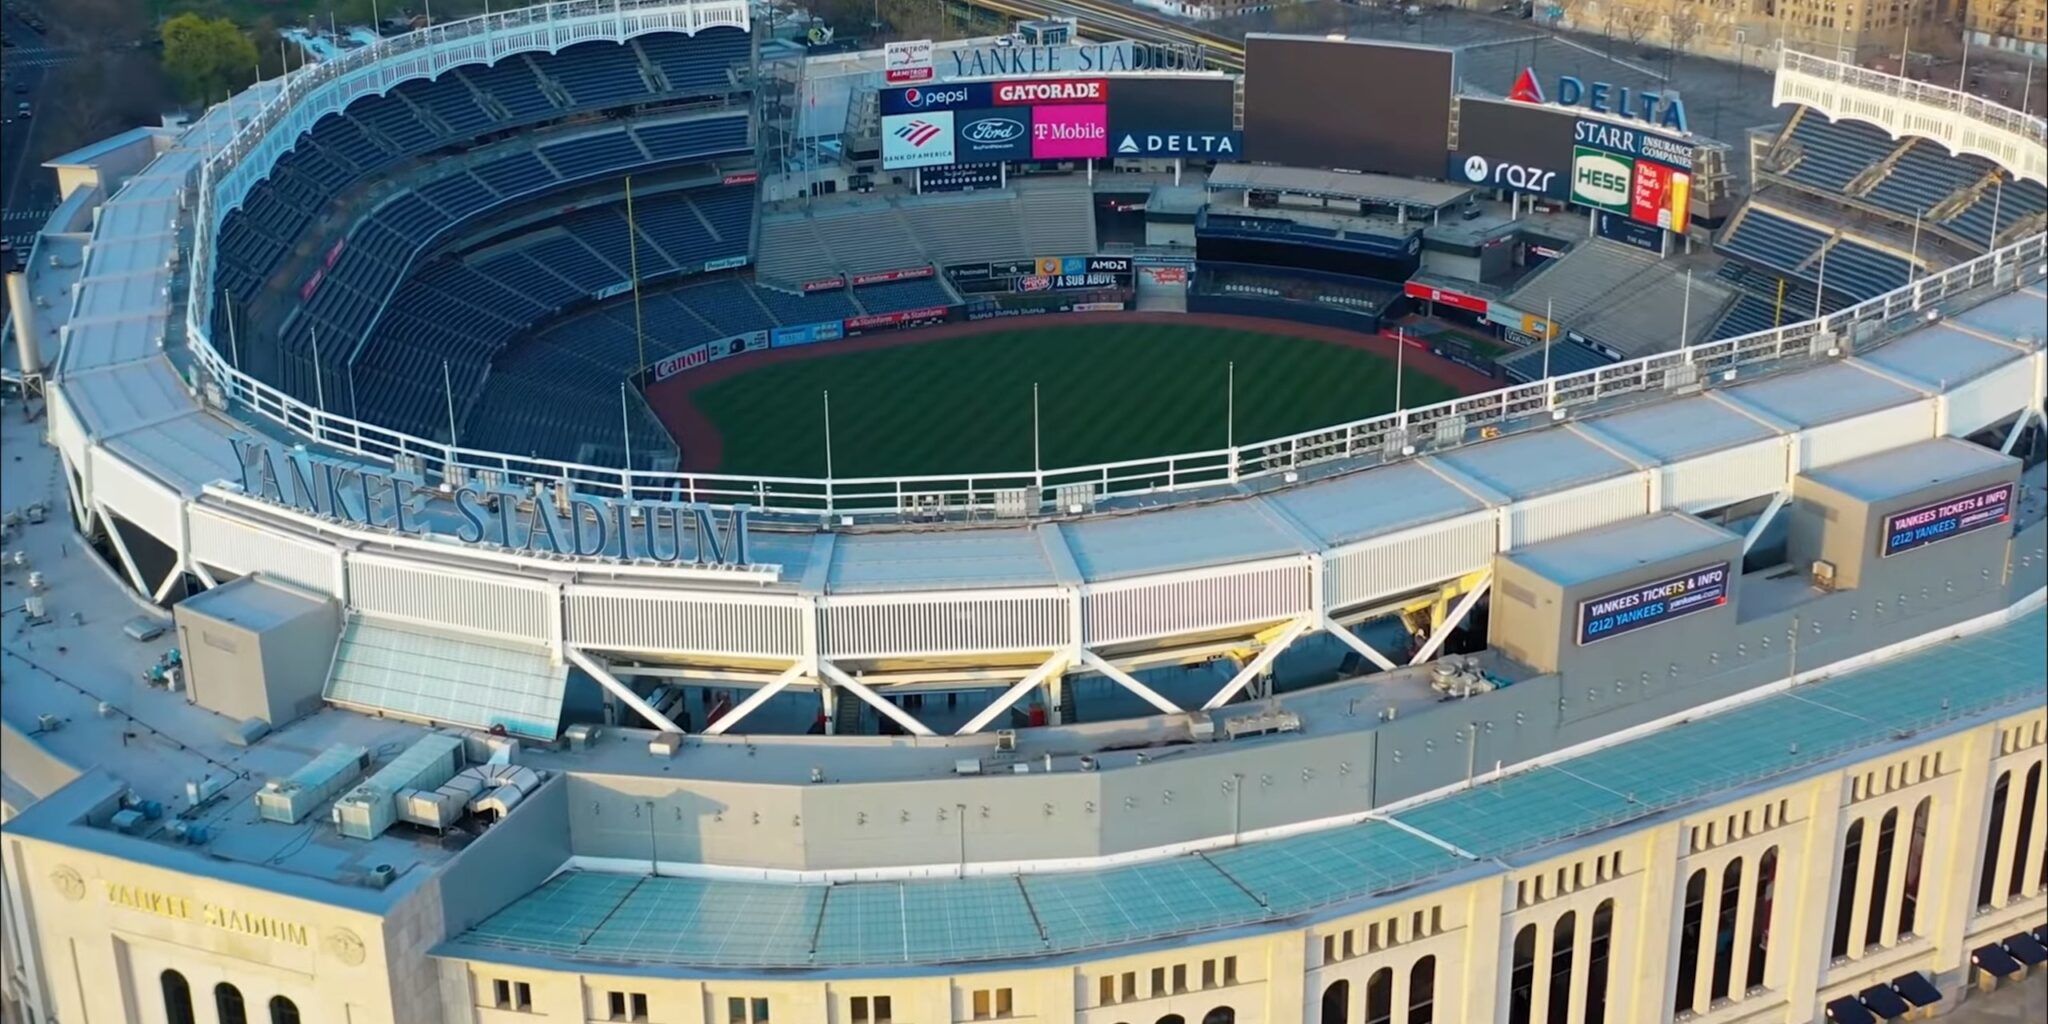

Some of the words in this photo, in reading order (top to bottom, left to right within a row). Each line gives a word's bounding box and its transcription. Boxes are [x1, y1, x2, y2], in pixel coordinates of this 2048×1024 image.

[889, 46, 929, 54] ARMITRON
[952, 46, 1061, 76] YANKEE
[1078, 43, 1206, 72] STADIUM
[926, 87, 968, 106] pepsi
[1000, 83, 1100, 101] GATORADE
[1558, 76, 1688, 132] DELTA
[973, 121, 1014, 139] Ford
[1051, 122, 1105, 140] Mobile
[1574, 121, 1636, 153] STARR
[917, 151, 953, 159] AMERICA
[1147, 135, 1233, 153] DELTA
[1643, 135, 1694, 157] INSURANCE
[1642, 146, 1692, 168] COMPANIES
[1494, 162, 1557, 192] razr
[1578, 167, 1627, 194] HESS
[1637, 164, 1657, 177] This
[1636, 186, 1651, 197] For
[1637, 175, 1660, 189] Bud's
[1091, 260, 1116, 270] AMD
[1057, 275, 1064, 287] A
[1065, 274, 1085, 286] SUB
[1086, 273, 1117, 285] ABOVE
[656, 348, 707, 378] Canon
[228, 436, 428, 534] YANKEE
[454, 483, 751, 566] STADIUM
[1894, 510, 1937, 531] YANKEES
[1938, 499, 1976, 518] TICKETS
[1976, 496, 1983, 507] &
[1985, 489, 2008, 504] INFO
[1891, 532, 1914, 548] (212)
[1915, 518, 1957, 540] YANKEES
[1591, 593, 1640, 617] YANKEES
[1642, 580, 1686, 603] TICKETS
[1687, 578, 1695, 590] &
[1697, 570, 1723, 587] INFO
[1588, 616, 1615, 635] (212)
[1616, 602, 1665, 626] YANKEES
[1669, 587, 1721, 611] yankees.com
[105, 880, 192, 920] YANKEE
[203, 902, 309, 947] STADIUM
